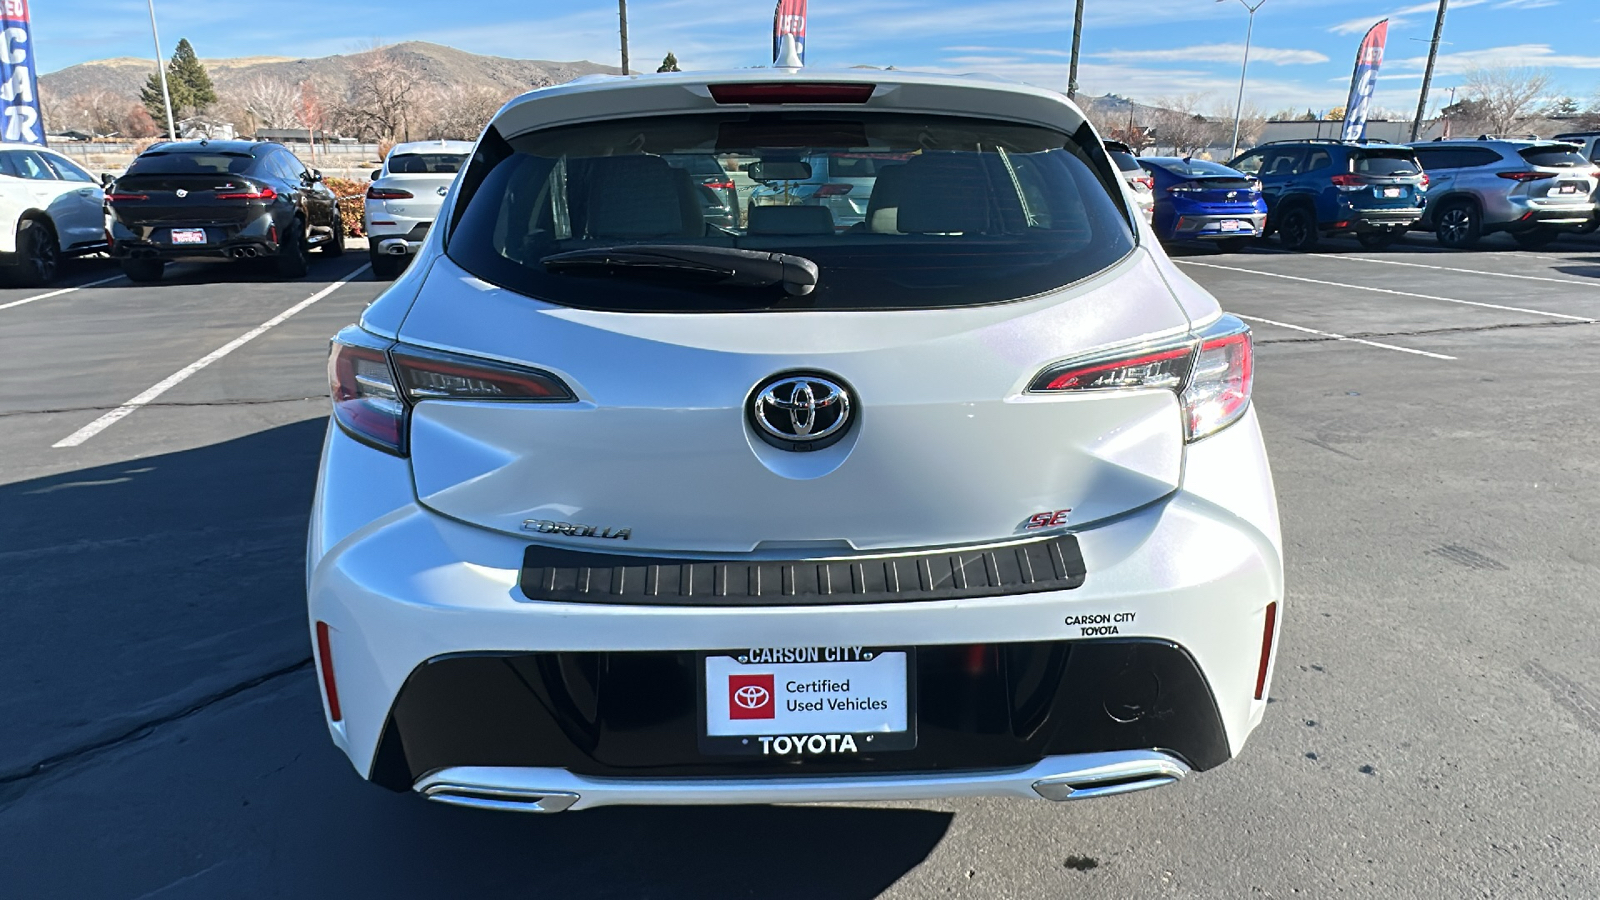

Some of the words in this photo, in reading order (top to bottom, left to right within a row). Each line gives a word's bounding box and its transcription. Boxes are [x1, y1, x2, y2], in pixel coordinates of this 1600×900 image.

[780, 15, 805, 32] USED
[1025, 508, 1072, 529] SE
[521, 518, 632, 540] COROLLA
[1064, 614, 1111, 626] CARSON
[1113, 612, 1136, 623] CITY
[1080, 625, 1119, 637] TOYOTA
[750, 647, 819, 663] CARSON
[825, 646, 863, 662] CITY
[786, 679, 850, 693] Certified
[786, 699, 824, 712] Used
[827, 697, 888, 711] Vehicles
[758, 734, 858, 755] TOYOTA
